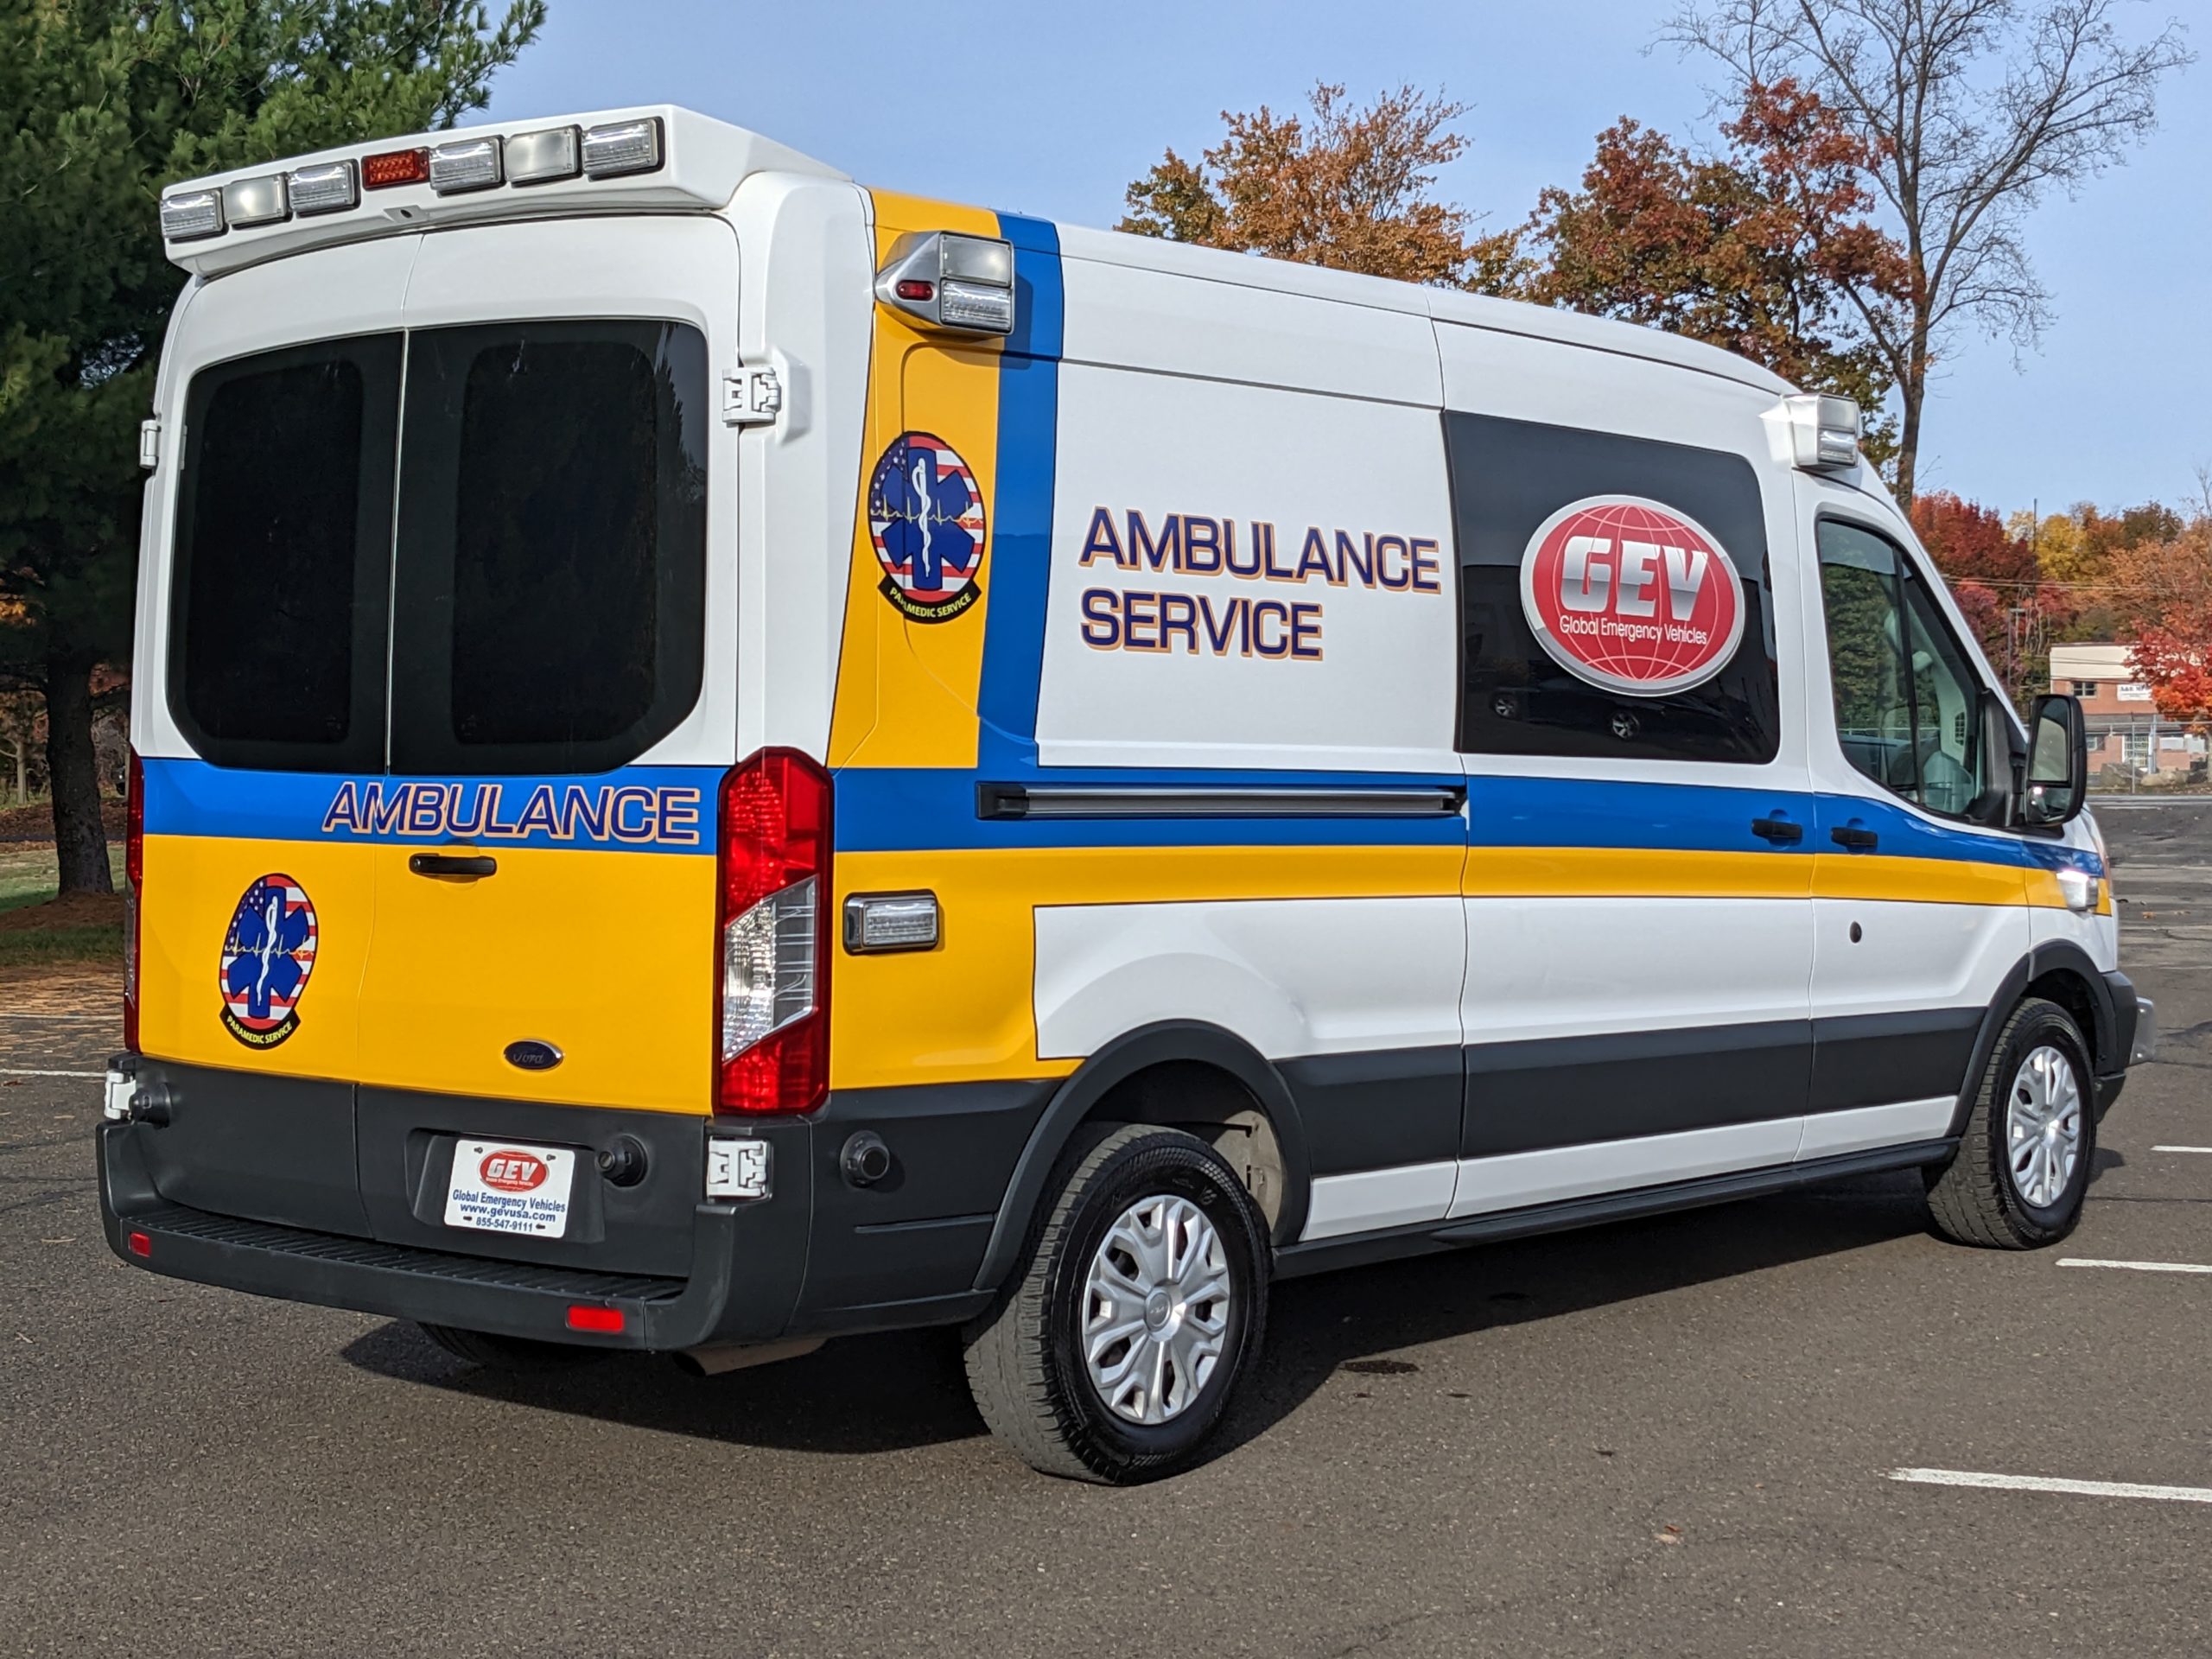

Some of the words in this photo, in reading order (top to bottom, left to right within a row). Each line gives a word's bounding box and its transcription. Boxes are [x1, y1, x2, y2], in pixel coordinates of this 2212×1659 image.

[1078, 505, 1442, 594] AMBULANCE
[1560, 536, 1708, 621] GEV
[937, 592, 972, 617] SERVICE
[1080, 587, 1324, 661] SERVICE
[1560, 614, 1599, 635] Global
[1601, 618, 1662, 643] Emergency
[1664, 623, 1708, 645] Vehicles
[321, 781, 700, 844] AMBULANCE
[226, 1015, 264, 1044] PARAMEDIC
[265, 1020, 292, 1044] SERVICE
[486, 1158, 538, 1181] GEV
[453, 1189, 479, 1203] Global
[480, 1192, 527, 1210] Emergency
[530, 1197, 566, 1212] Vehicles
[460, 1203, 556, 1222] www.gevusa.com
[476, 1217, 533, 1231] 855-547-9111
